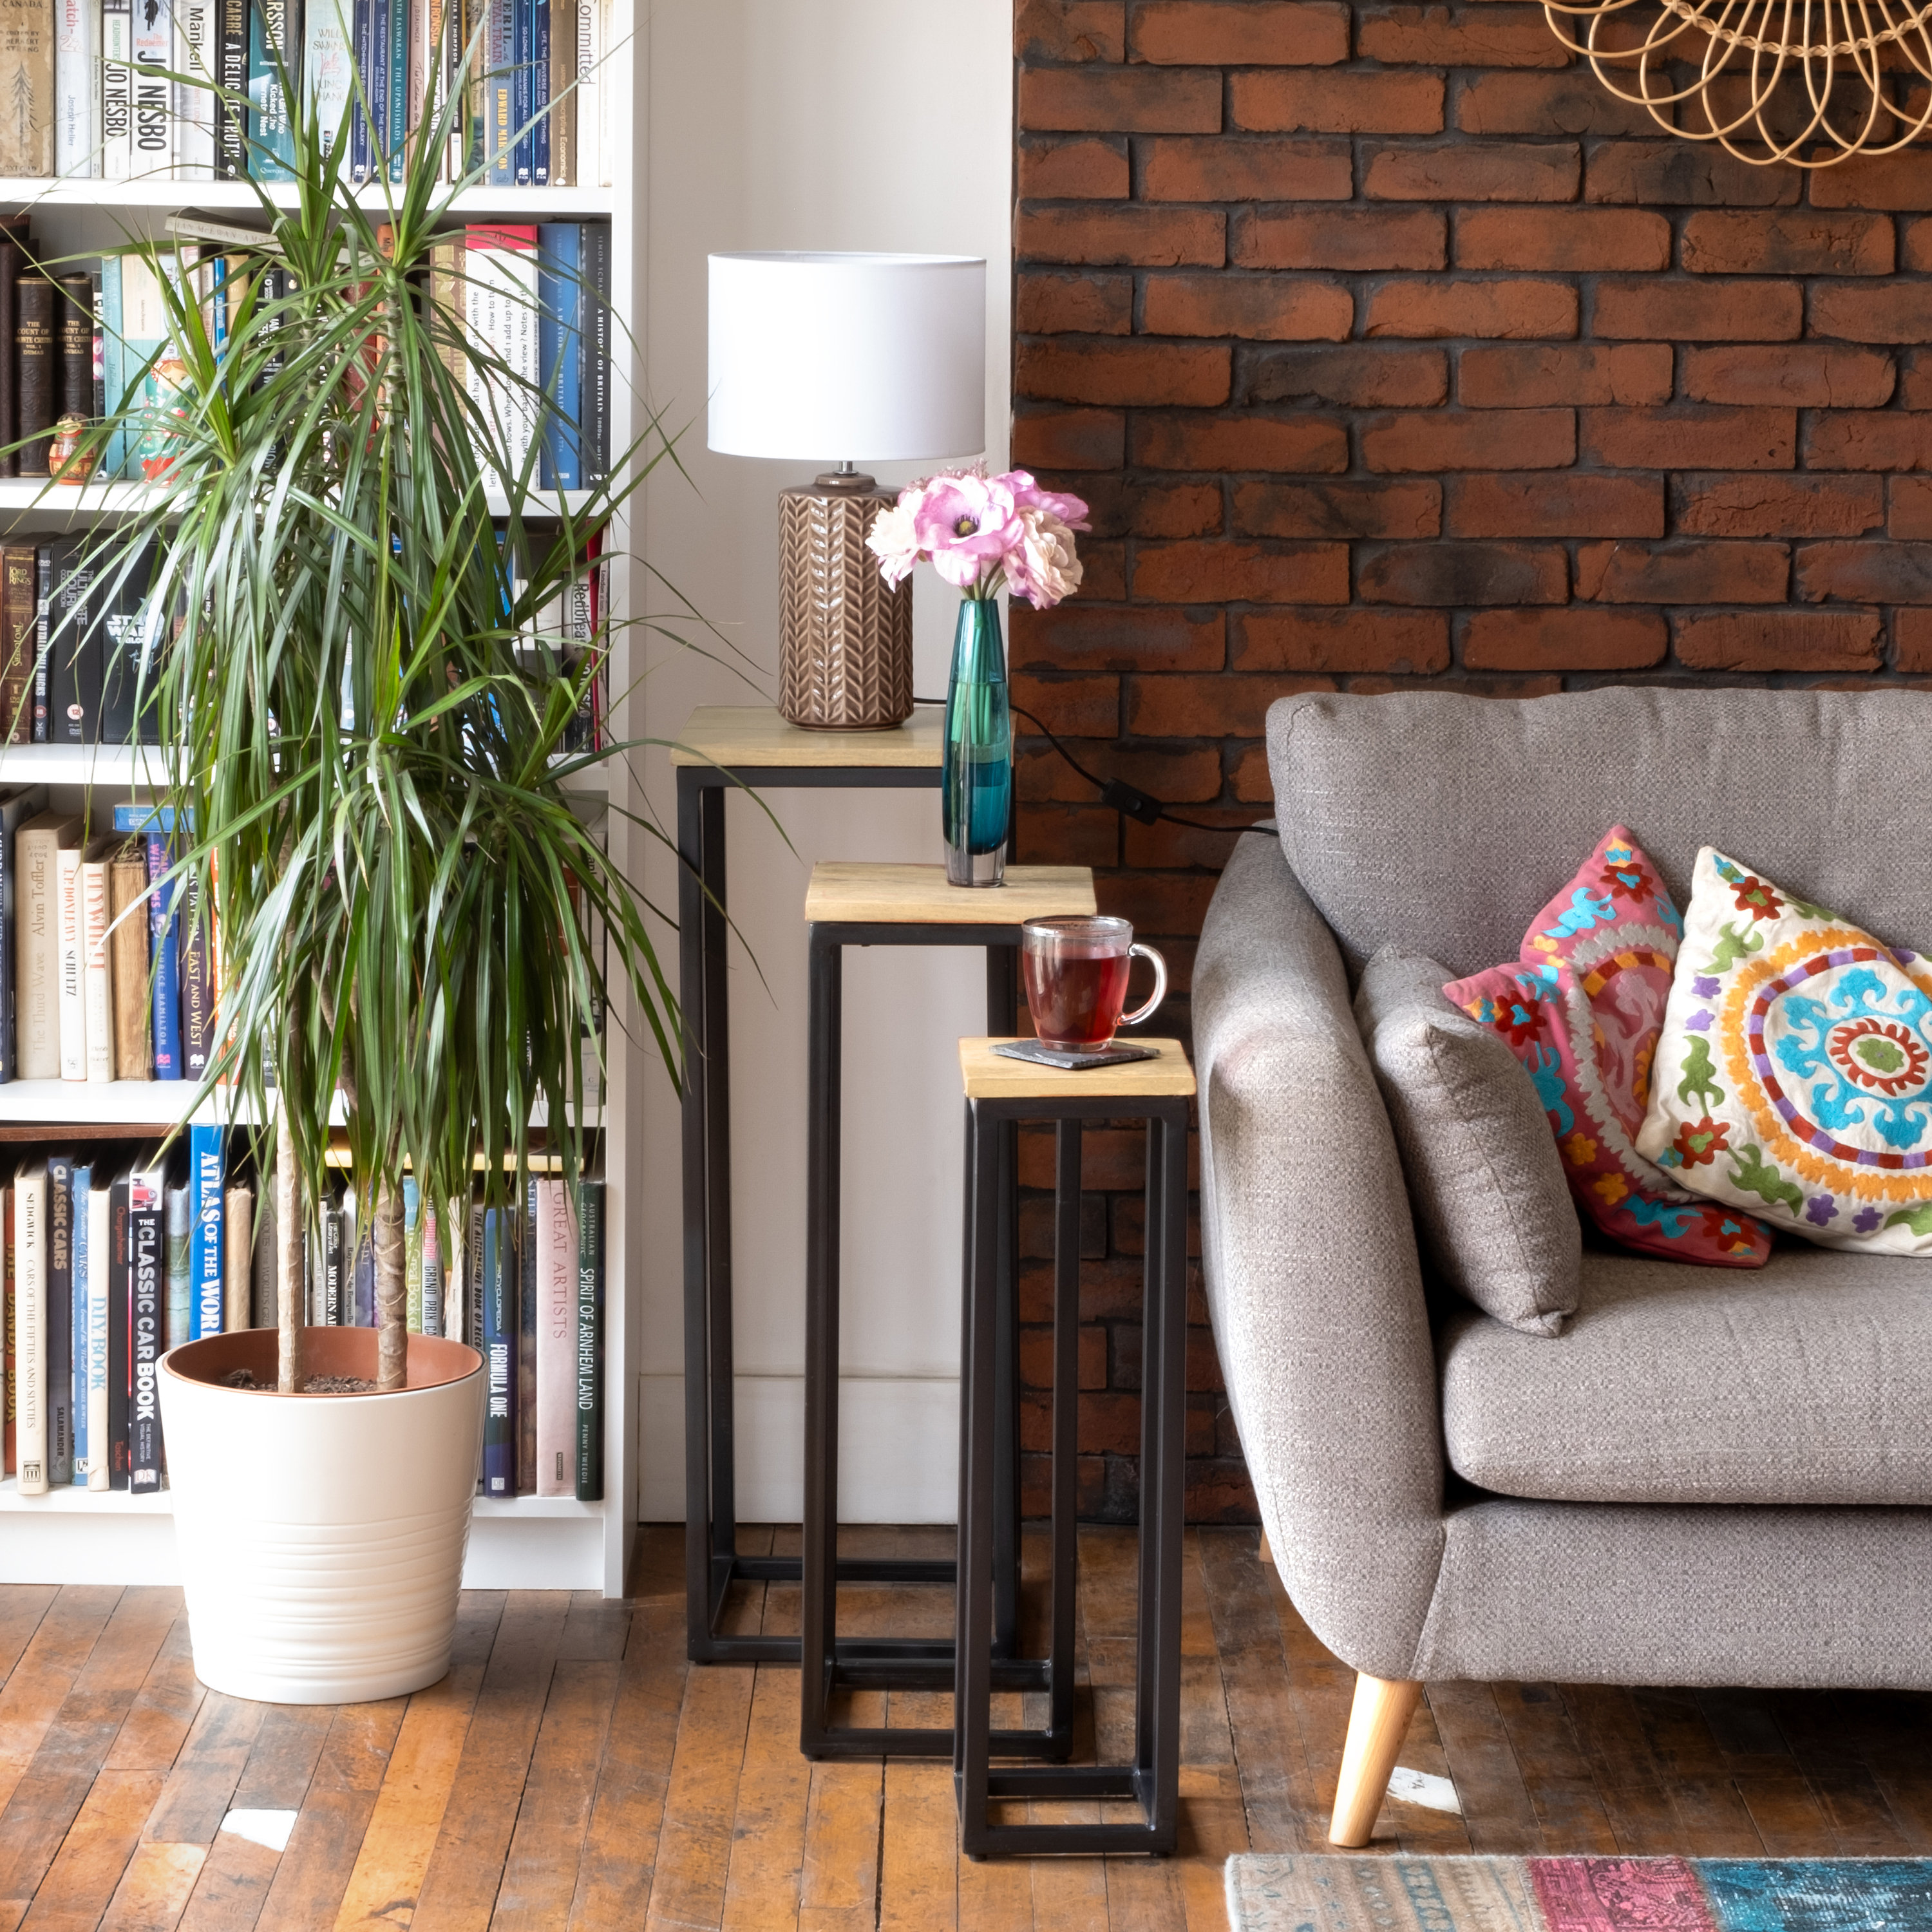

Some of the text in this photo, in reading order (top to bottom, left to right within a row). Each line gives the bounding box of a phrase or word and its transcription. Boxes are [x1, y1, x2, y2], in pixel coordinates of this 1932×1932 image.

[2, 0, 43, 8] CANADA
[112, 19, 121, 61] HEADHUNTERS
[136, 39, 168, 47] Redeemer
[189, 7, 204, 71] Mankell
[225, 43, 241, 51] A
[430, 8, 441, 47] RONSON
[491, 28, 503, 63] TRAIN
[225, 55, 242, 111] DELICTE
[378, 66, 386, 75] AT
[393, 16, 402, 141] EASWARAN THE UPANISHADS
[105, 62, 128, 137] JO NESBO
[137, 85, 167, 151] NESBO
[269, 84, 278, 115] Kicked
[377, 103, 384, 112] OF
[497, 88, 507, 126] EDWARD
[67, 95, 77, 147] Joseph Heller
[259, 116, 269, 137] Nest
[559, 136, 568, 178] Economics
[489, 300, 495, 309] to
[504, 310, 513, 322] up
[503, 324, 511, 341] add
[596, 359, 604, 371] OF
[596, 374, 604, 413] BRITAIN
[36, 620, 48, 652] TOTALLY
[35, 672, 46, 697] HICKS
[30, 860, 46, 900] Toffler
[30, 903, 45, 937] Alvin
[32, 951, 46, 1054] The Third Wave
[158, 993, 167, 1046] HAMILTON
[189, 951, 202, 1048] EAST AND WEST
[53, 1164, 68, 1270] CLASSIC CARS
[200, 1151, 220, 1277] ATLAS OF THE
[78, 1242, 89, 1279] CARS
[424, 1265, 437, 1295] GRAND
[474, 1212, 483, 1324] THE BOOK OF
[553, 1191, 567, 1340] GREAT ARTISTS
[262, 1265, 271, 1305] WORLD'S
[327, 1265, 337, 1312] MODERN
[408, 1249, 421, 1331] Great Book of
[26, 1191, 36, 1429] SEDGWICK CARS OF THE FIFTIES AND SIXTIES
[136, 1226, 155, 1421] CLASSIC CAR BOOK
[424, 1300, 437, 1321] PRIX
[579, 1267, 594, 1410] SPIRIT OF ARNHEM LAND
[91, 1339, 106, 1392] BOOK
[489, 1343, 507, 1418] FORMULA ONE
[56, 1406, 64, 1457] SALAMANDER
[115, 1440, 124, 1472] Taschen
[135, 1469, 157, 1484] DK
